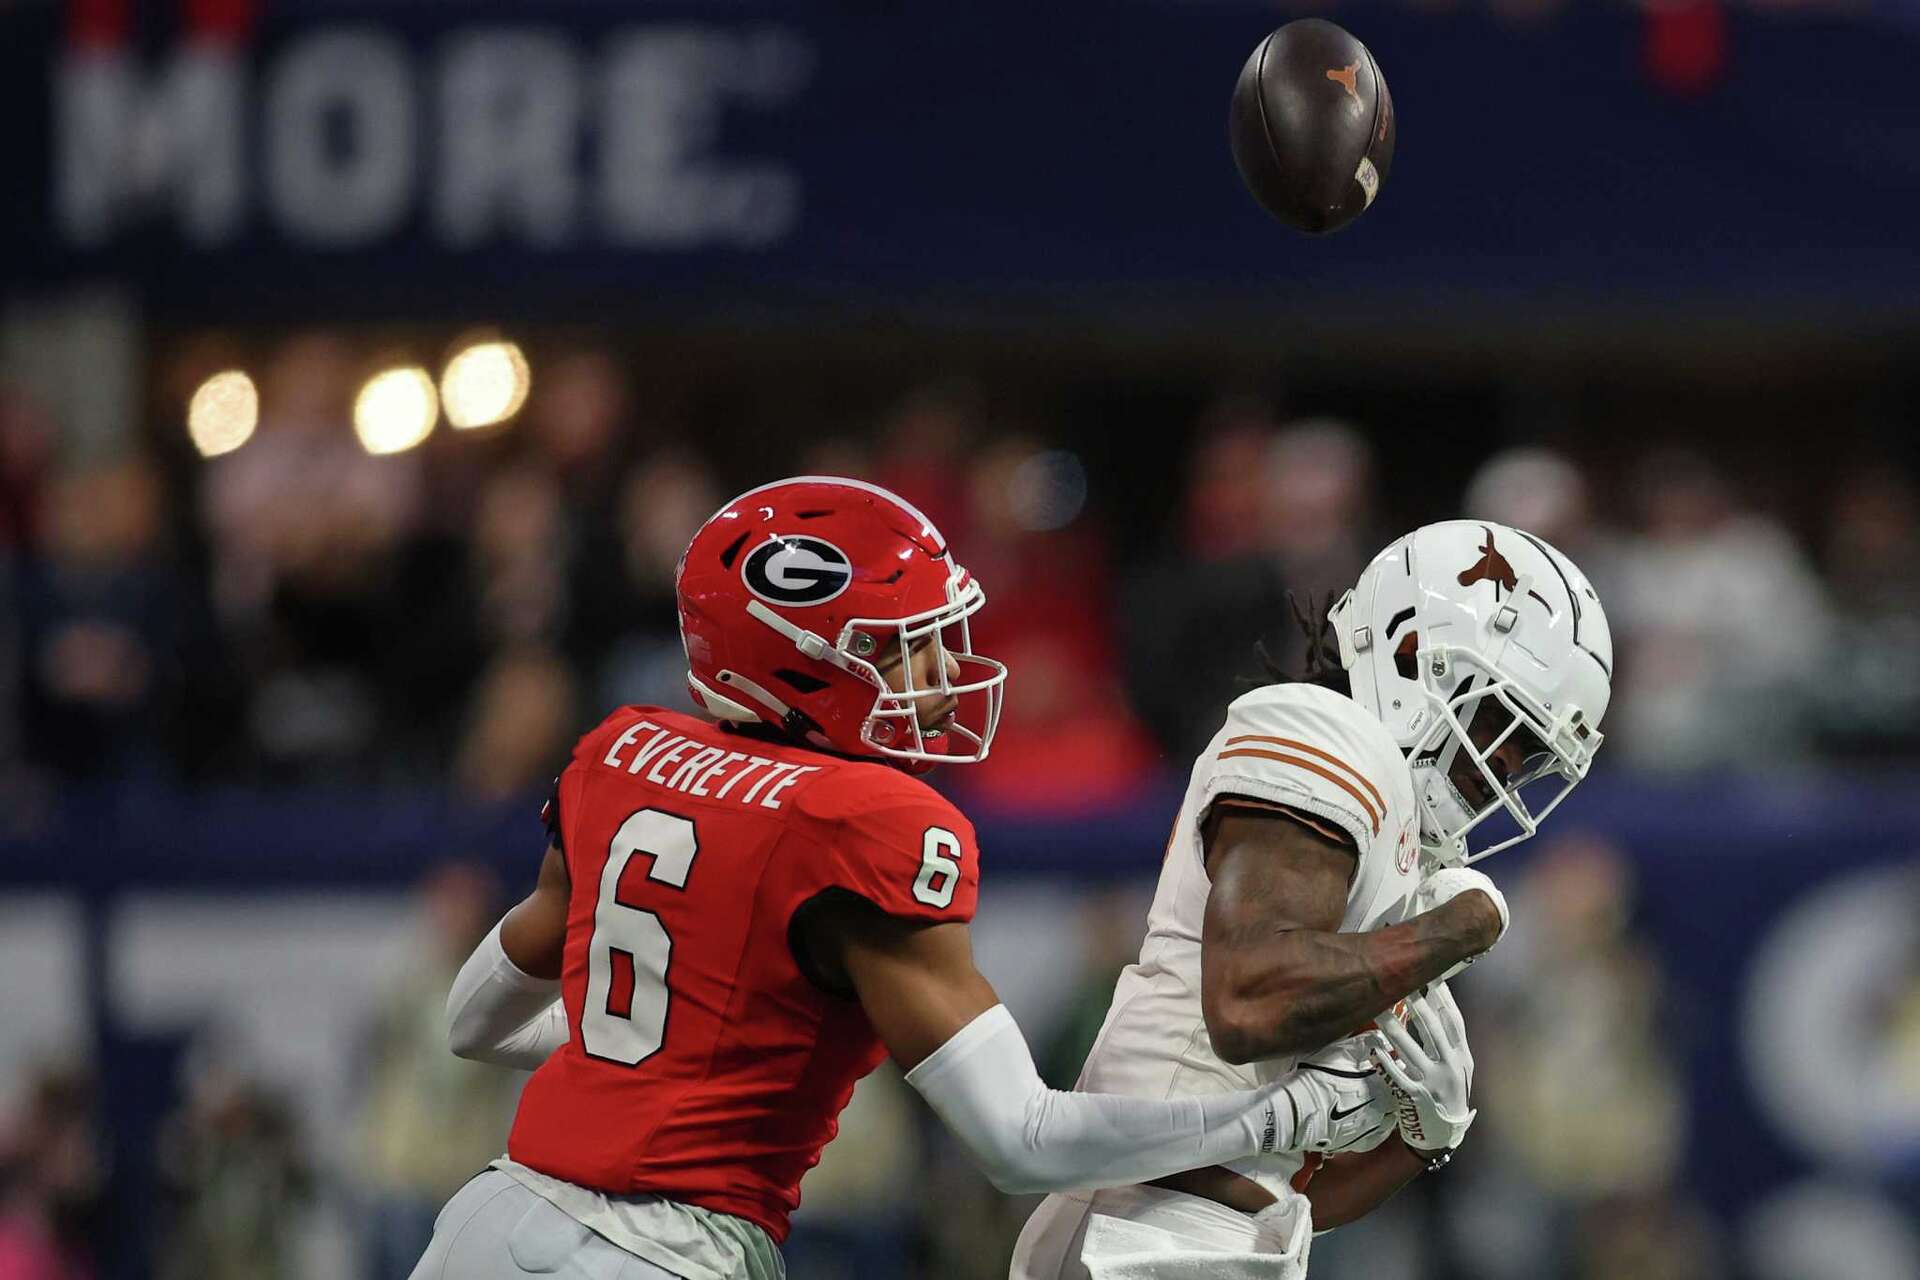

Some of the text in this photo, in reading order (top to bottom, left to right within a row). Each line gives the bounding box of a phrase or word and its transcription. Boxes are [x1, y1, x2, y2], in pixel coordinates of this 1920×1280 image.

[743, 536, 851, 606] G
[603, 720, 823, 810] EVERETTE
[911, 825, 962, 909] 6
[580, 807, 699, 1068] 6
